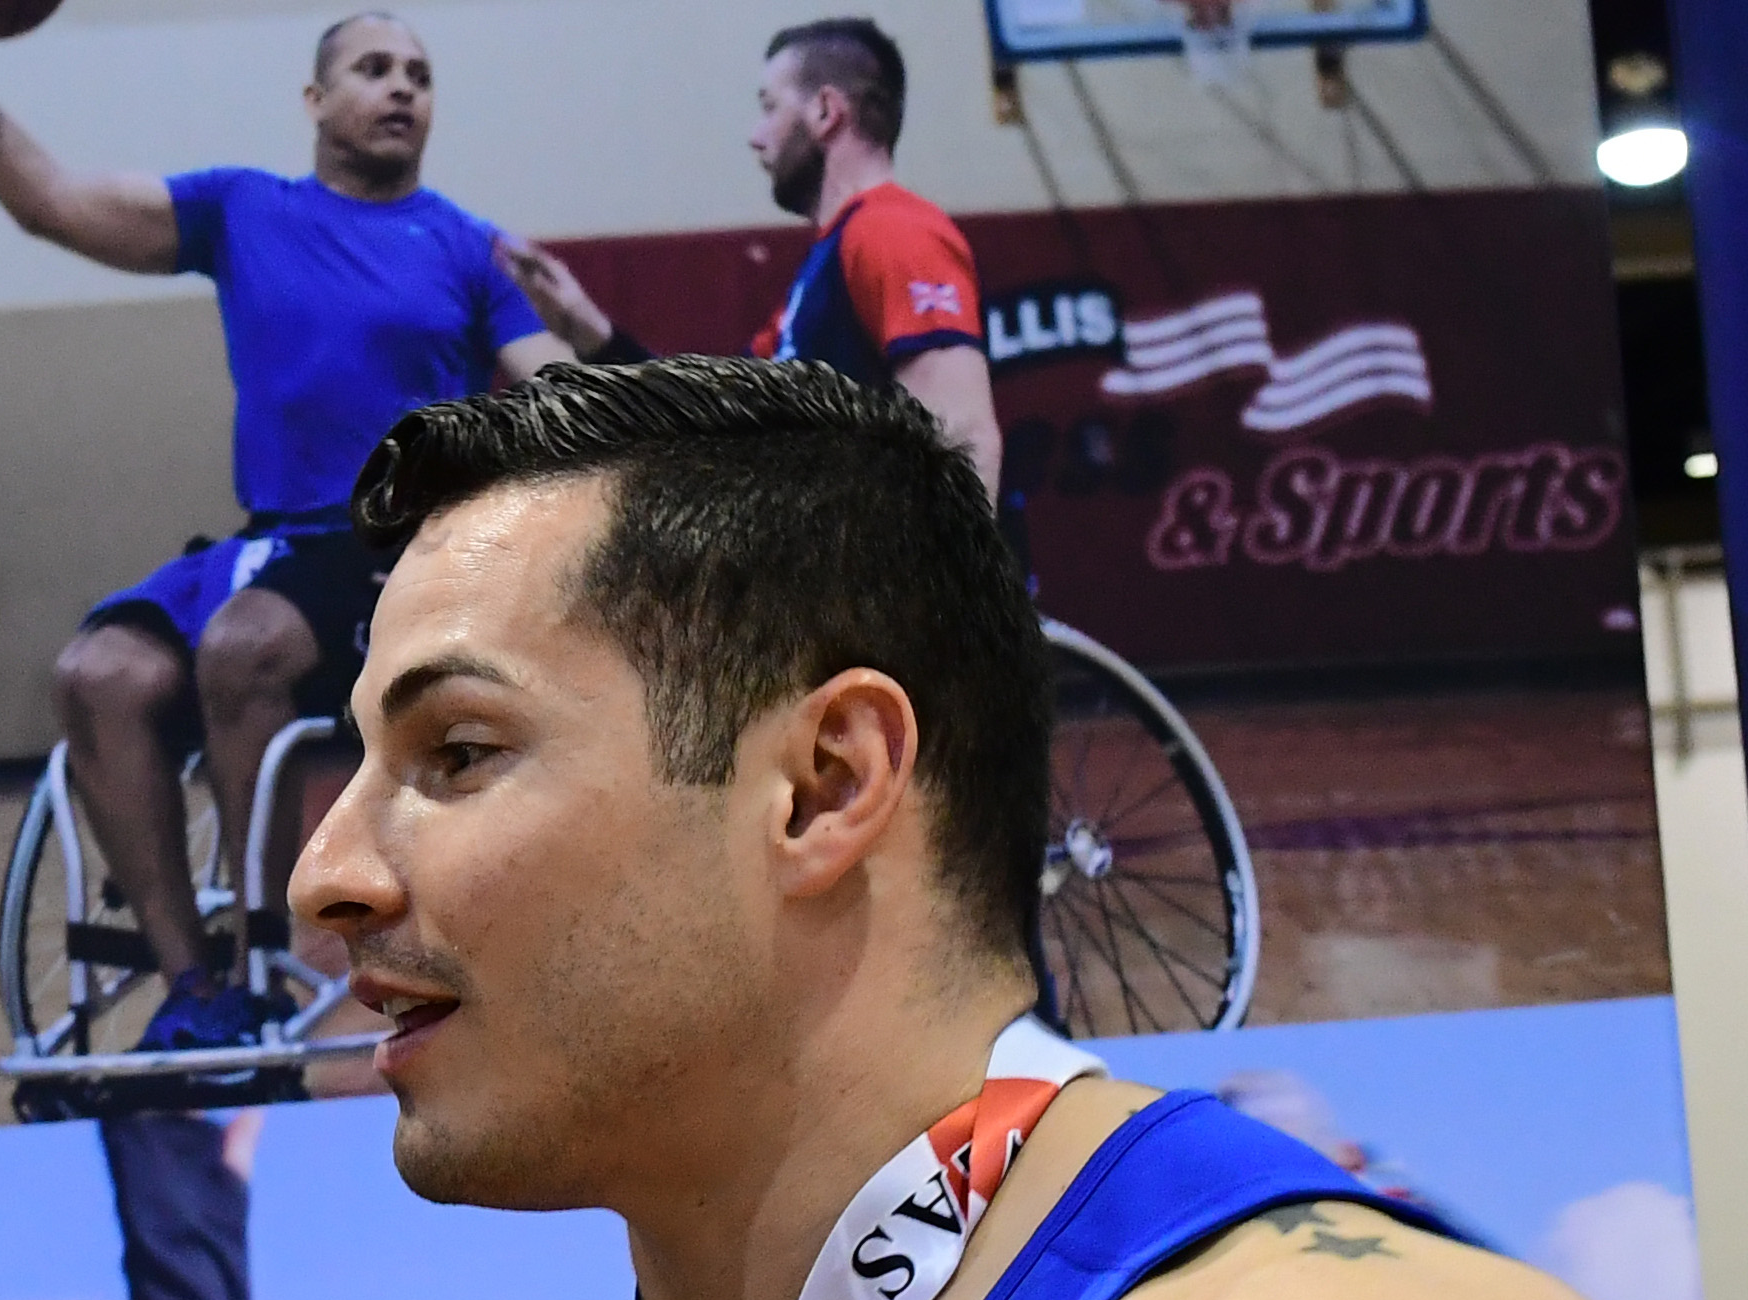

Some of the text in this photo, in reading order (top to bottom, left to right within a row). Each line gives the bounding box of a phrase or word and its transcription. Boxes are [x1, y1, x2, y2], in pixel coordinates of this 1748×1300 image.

[988, 291, 1119, 362] LLIS
[1148, 468, 1234, 572] &
[1244, 443, 1627, 572] Sports
